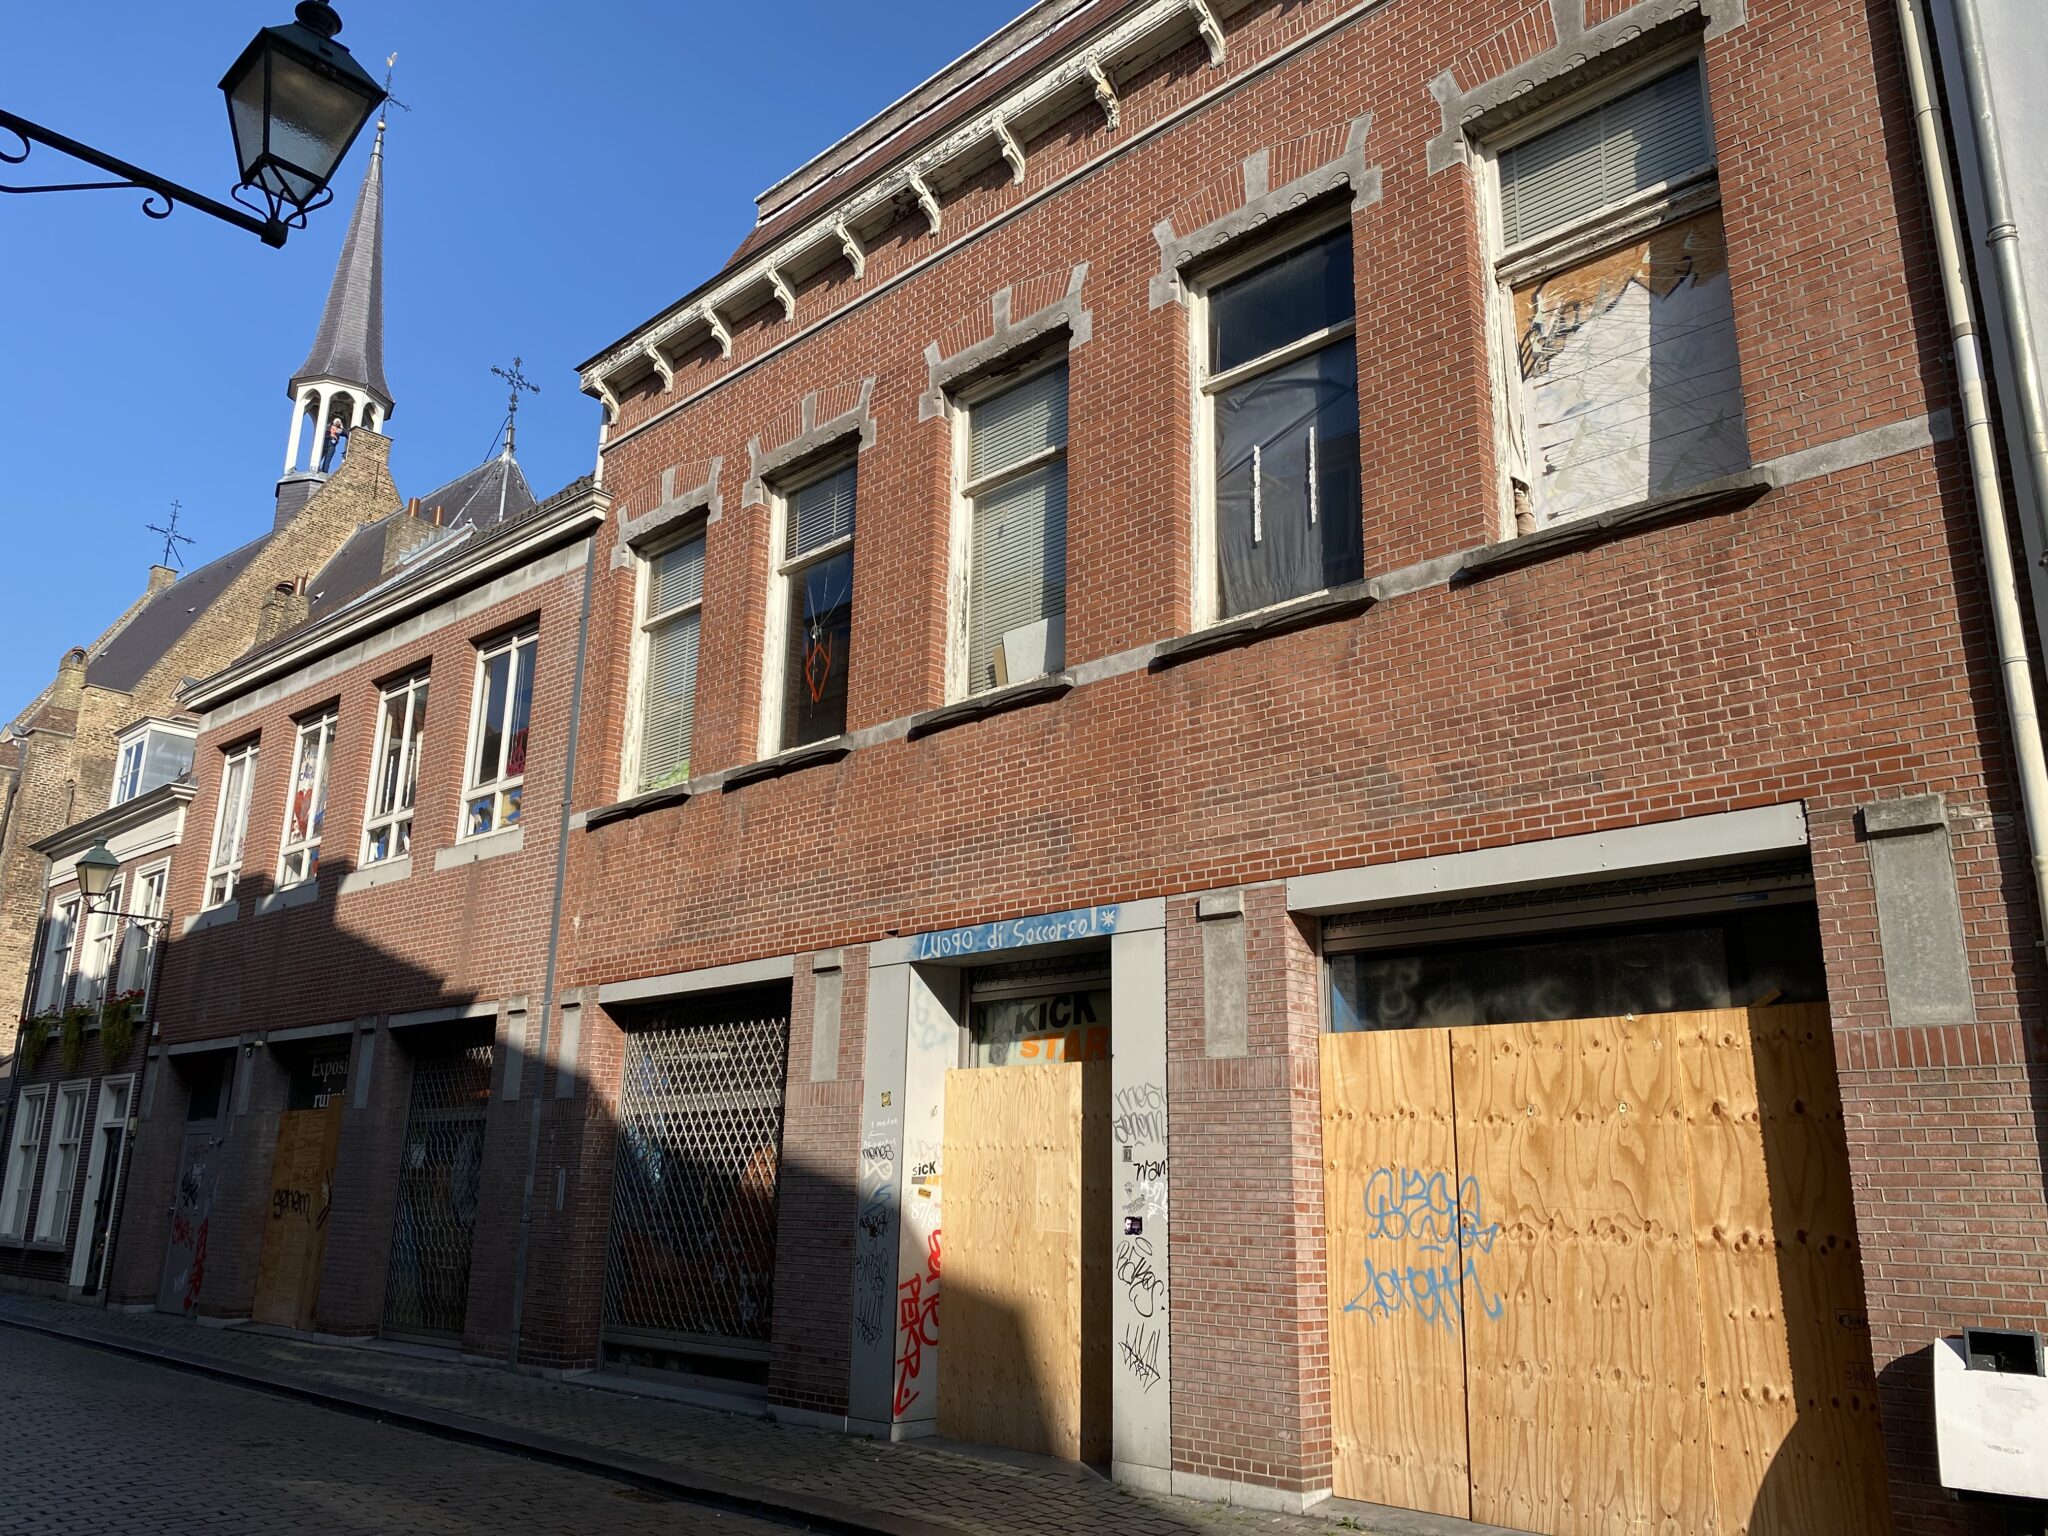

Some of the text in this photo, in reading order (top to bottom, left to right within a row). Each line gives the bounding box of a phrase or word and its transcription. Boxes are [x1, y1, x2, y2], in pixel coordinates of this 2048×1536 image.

[920, 929, 973, 960] Luogo
[987, 922, 1003, 949] di
[1015, 992, 1096, 1034] KICK
